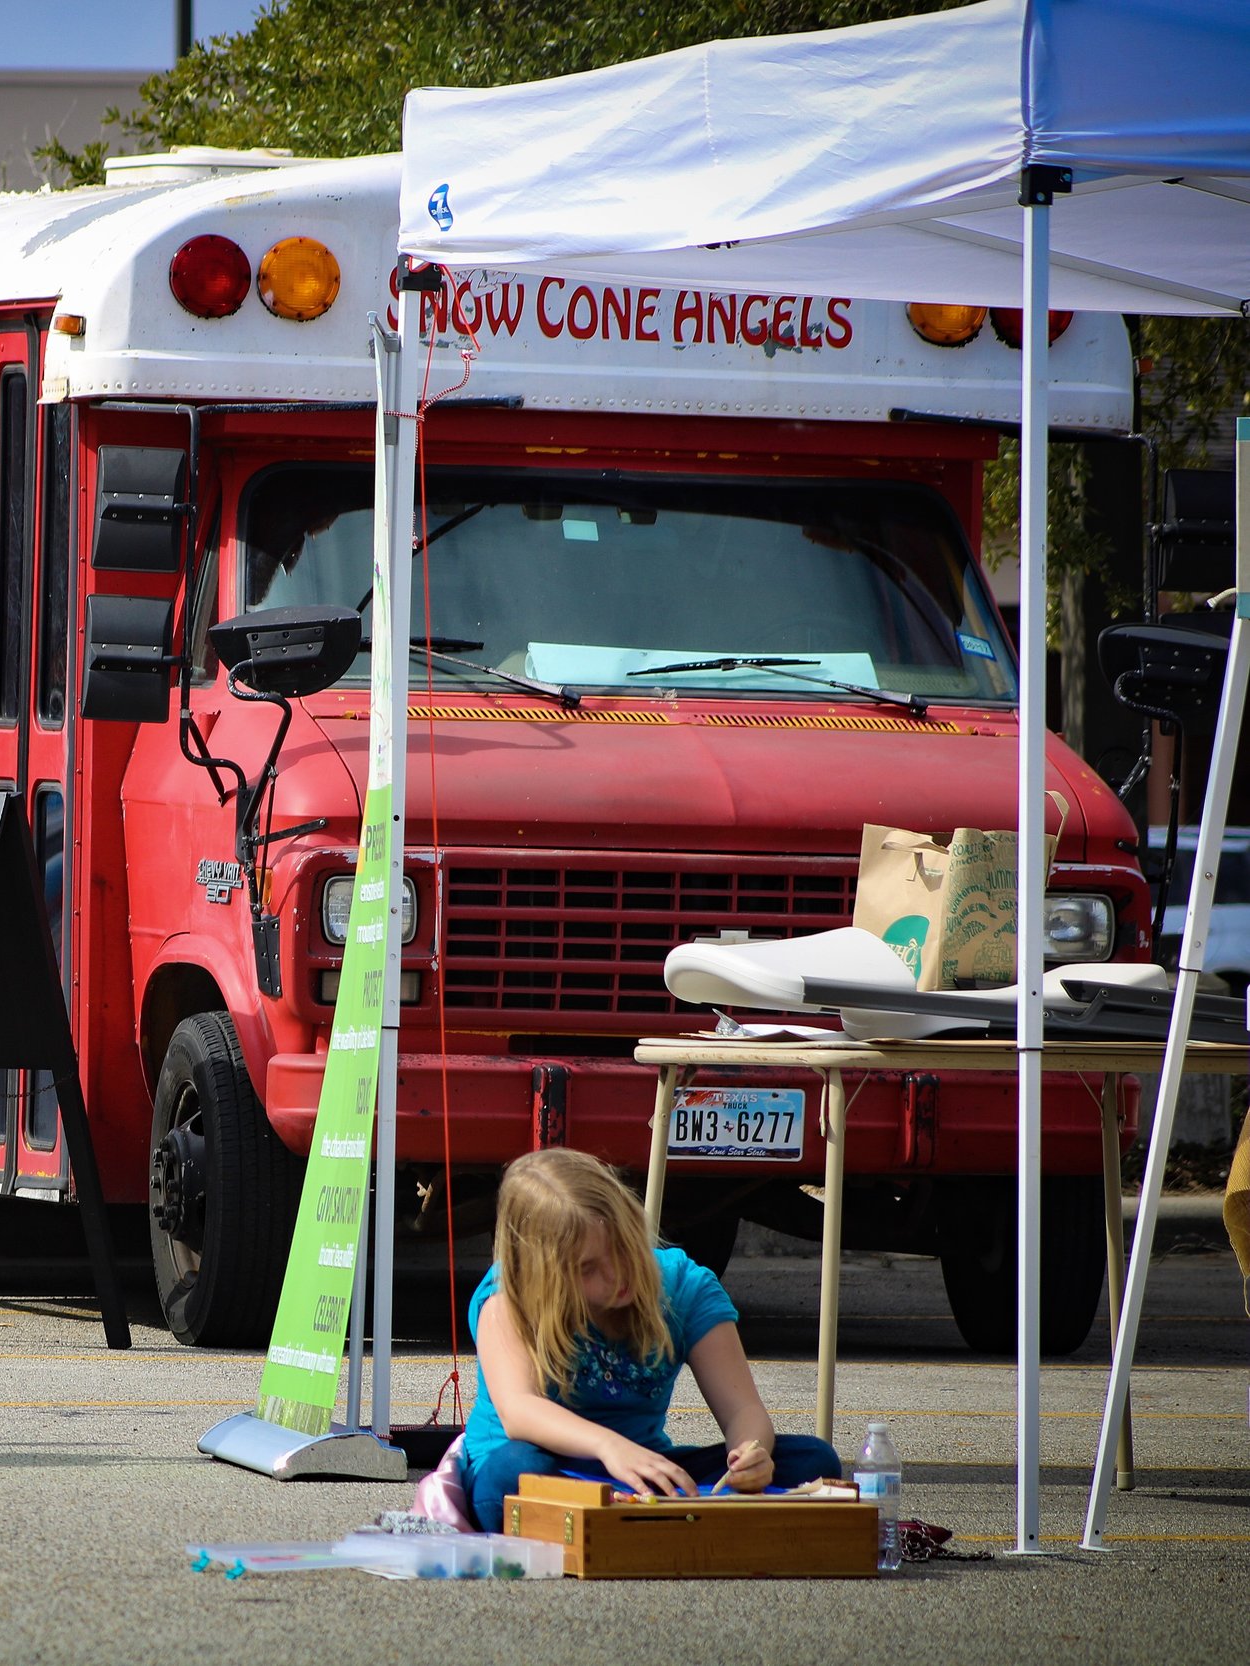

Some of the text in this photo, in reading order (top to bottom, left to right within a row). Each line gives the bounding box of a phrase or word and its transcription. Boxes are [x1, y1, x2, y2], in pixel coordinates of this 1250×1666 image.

[535, 275, 662, 342] CONE
[672, 290, 853, 349] ANGELS
[206, 882, 231, 903] 30
[712, 1092, 759, 1103] TEXAS
[723, 1102, 748, 1110] TRUCK
[675, 1110, 795, 1144] BW3 6277
[707, 1147, 726, 1156] Lone
[727, 1147, 745, 1156] Star
[746, 1148, 766, 1157] State
